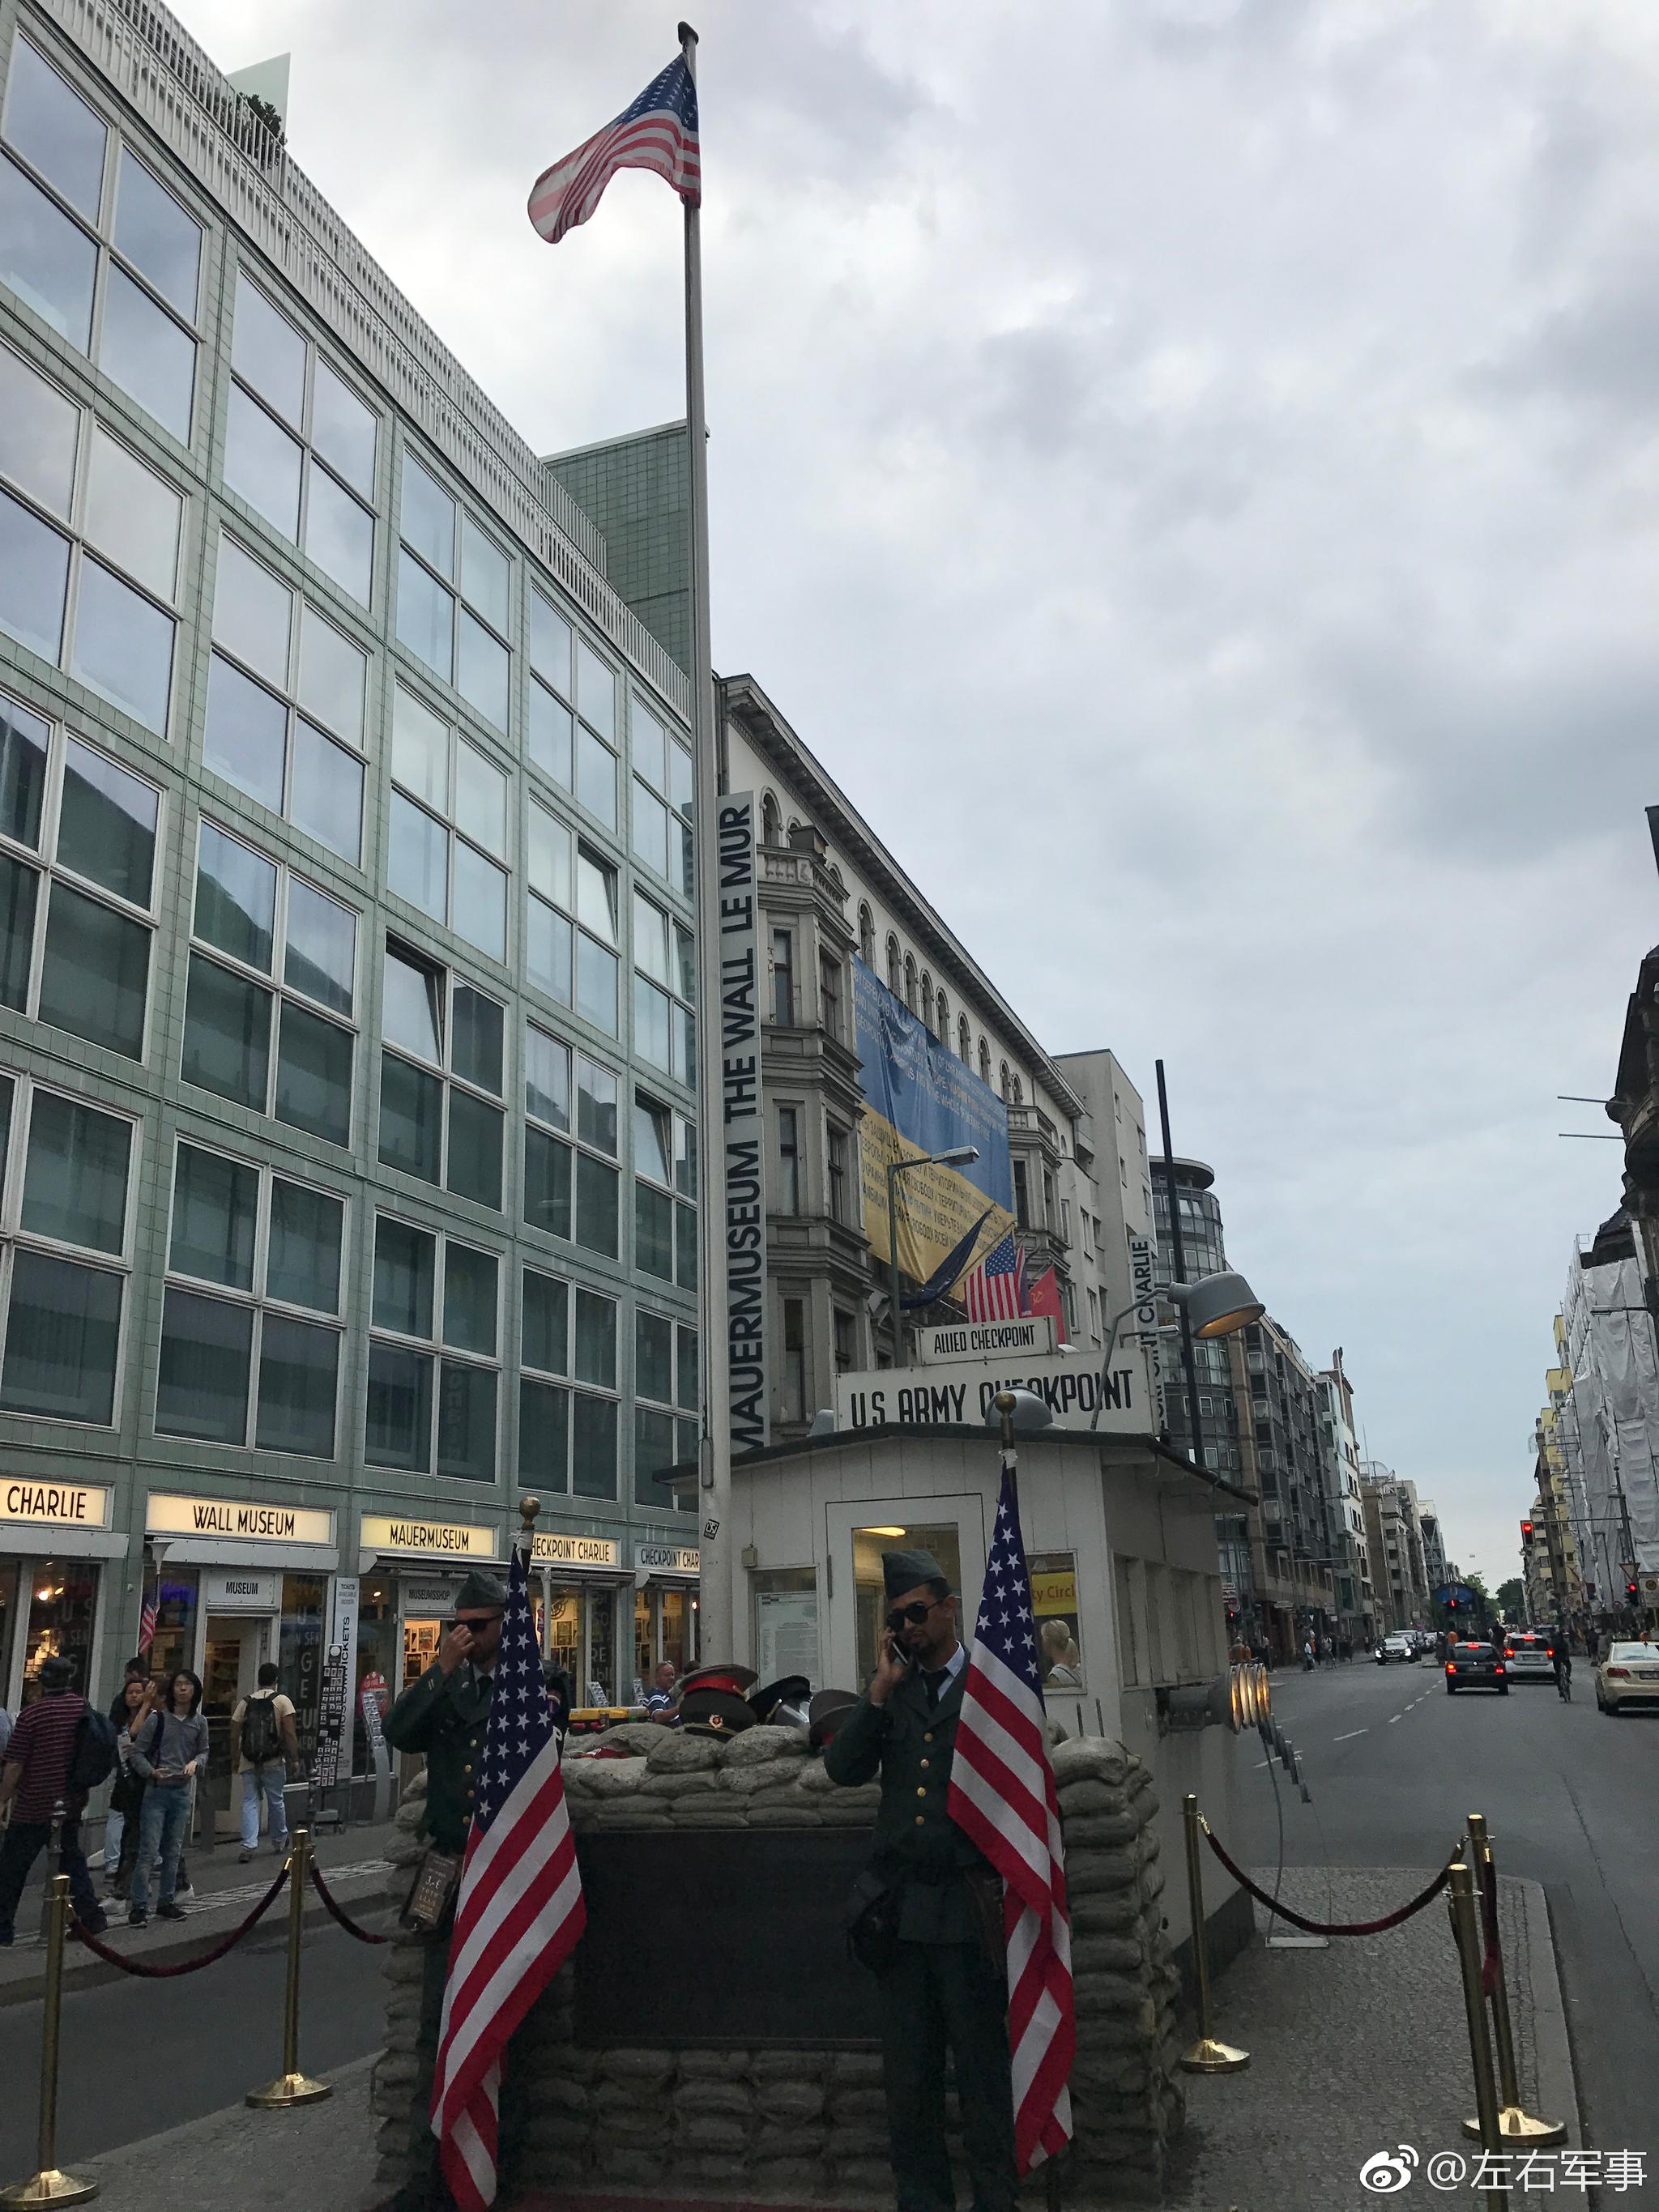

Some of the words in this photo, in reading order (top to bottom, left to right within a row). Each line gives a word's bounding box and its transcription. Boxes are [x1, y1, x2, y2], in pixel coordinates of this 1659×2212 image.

[719, 803, 752, 889] MUR
[721, 895, 753, 934] LE
[722, 947, 754, 1049] WALL
[724, 1055, 757, 1123] THE
[934, 1331, 967, 1354] ALLIED
[970, 1324, 1034, 1351] CHECKPOINT
[898, 1383, 966, 1423] ARMY
[7, 1485, 87, 1519] CHARLIE
[194, 1505, 232, 1532] WALL
[238, 1509, 295, 1536] MUSEUM
[390, 1524, 469, 1551] MAUERMUSEUM
[531, 1537, 576, 1559] HECKPOINT
[578, 1542, 609, 1562] CHARLIE
[641, 1548, 680, 1567] CHECKPOINT
[226, 1581, 258, 1595] MUSEUM
[1047, 1584, 1077, 1599] Circl
